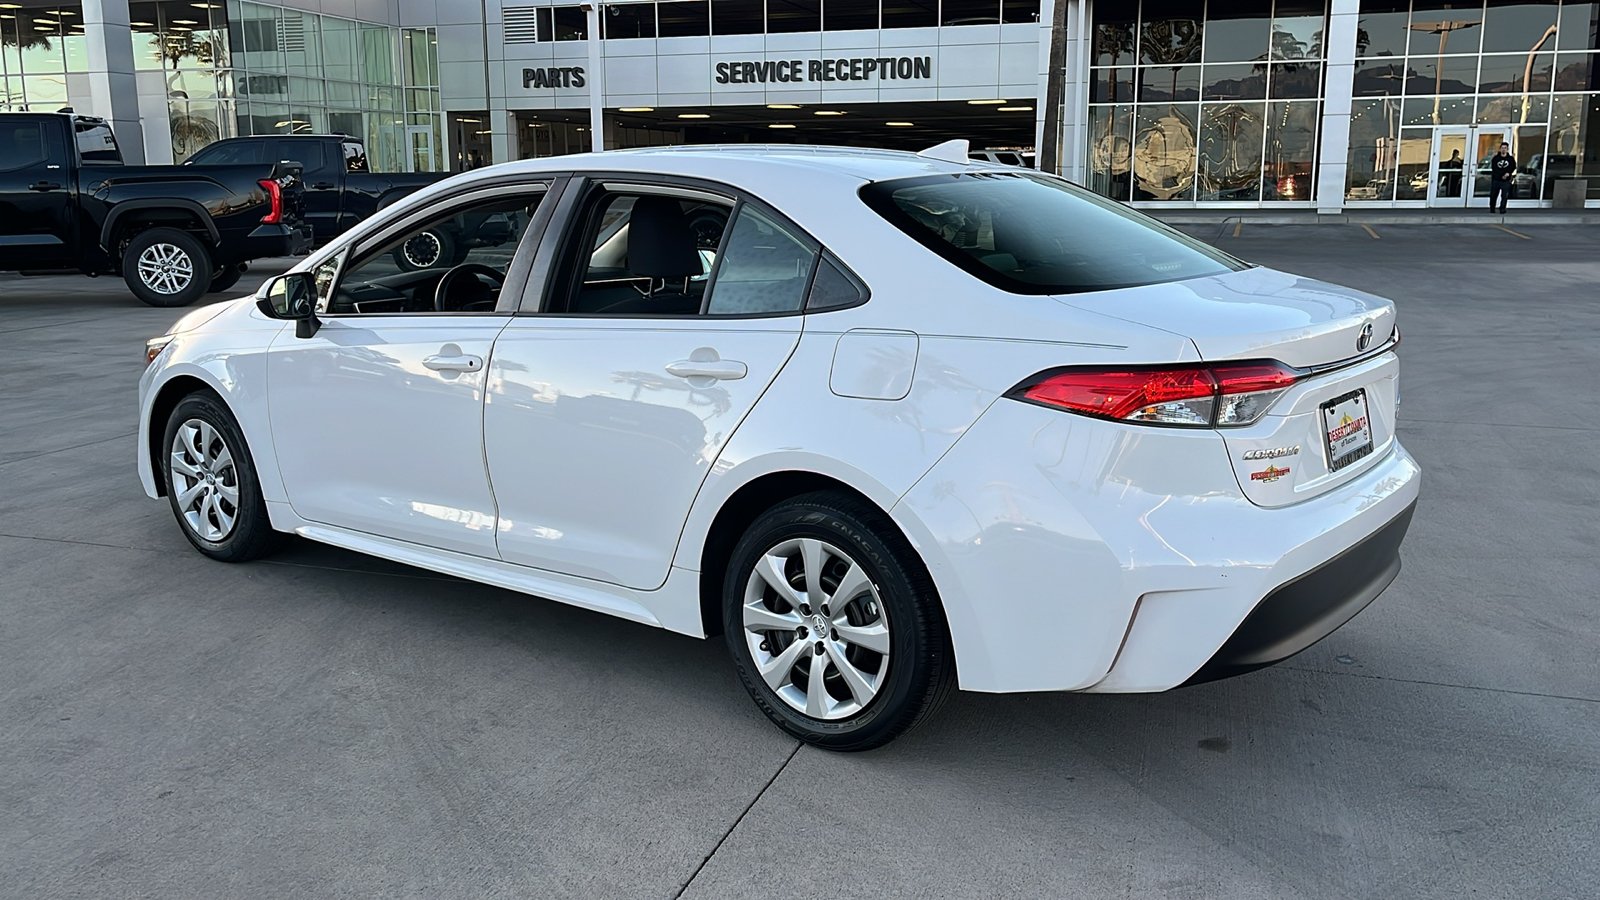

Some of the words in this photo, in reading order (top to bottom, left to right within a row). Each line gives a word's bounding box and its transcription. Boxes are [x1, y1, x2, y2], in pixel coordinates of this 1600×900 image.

[522, 66, 586, 89] PARTS
[715, 60, 804, 85] SERVICE
[807, 56, 931, 82] RECEPTION
